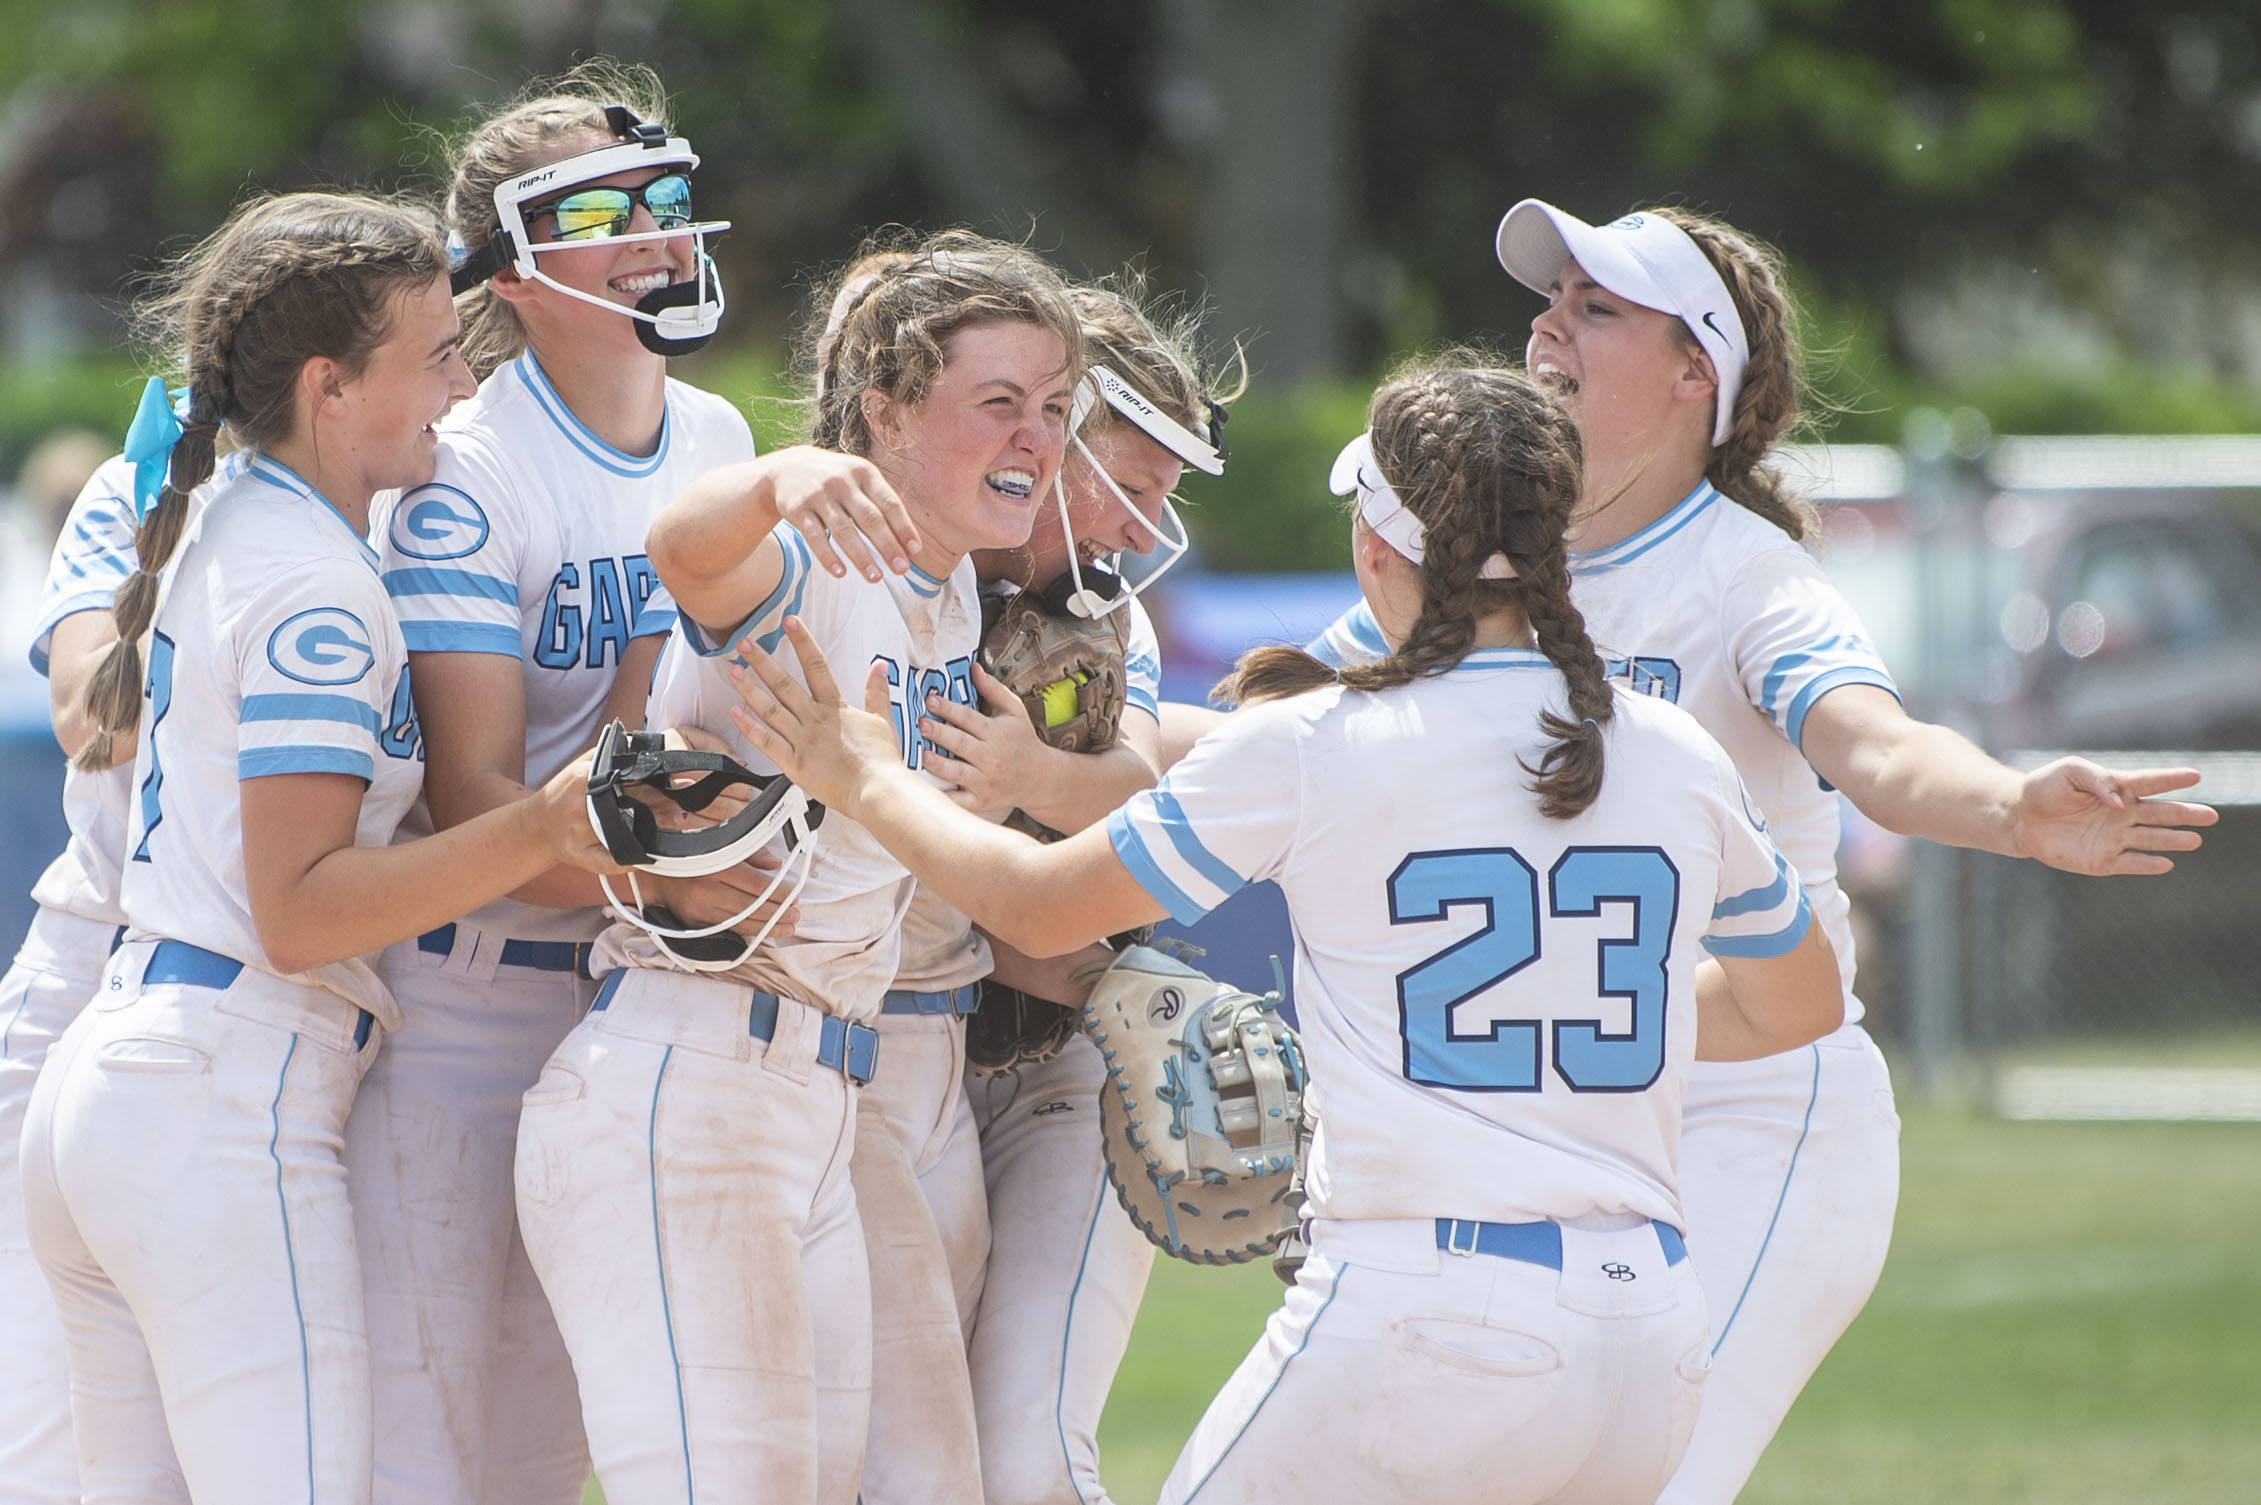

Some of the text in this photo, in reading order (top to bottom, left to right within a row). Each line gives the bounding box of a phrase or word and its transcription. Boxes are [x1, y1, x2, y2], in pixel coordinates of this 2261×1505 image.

[518, 169, 557, 190] RIP-IT
[1118, 389, 1155, 416] RIP-IT
[1387, 846, 1680, 1093] 23
